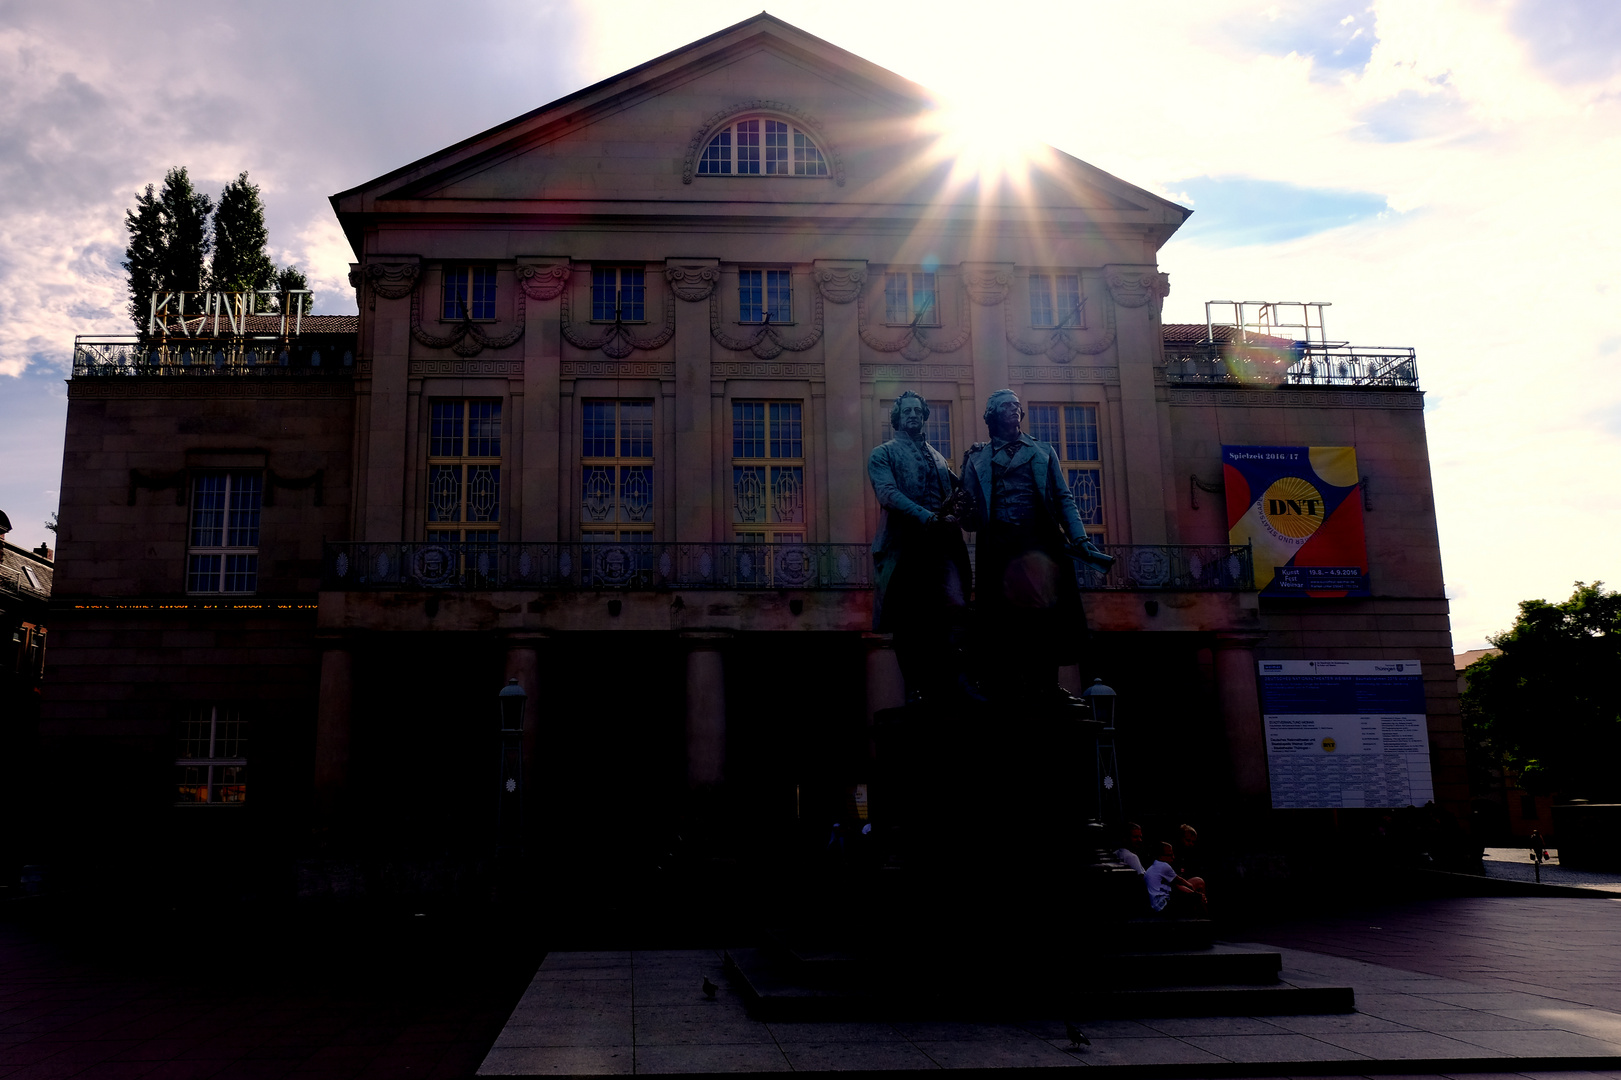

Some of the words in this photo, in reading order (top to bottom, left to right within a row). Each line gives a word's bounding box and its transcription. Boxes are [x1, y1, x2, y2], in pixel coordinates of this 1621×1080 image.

[149, 289, 313, 340] KUNST
[1229, 452, 1264, 460] Spielzeit
[1268, 499, 1320, 516] DNT
